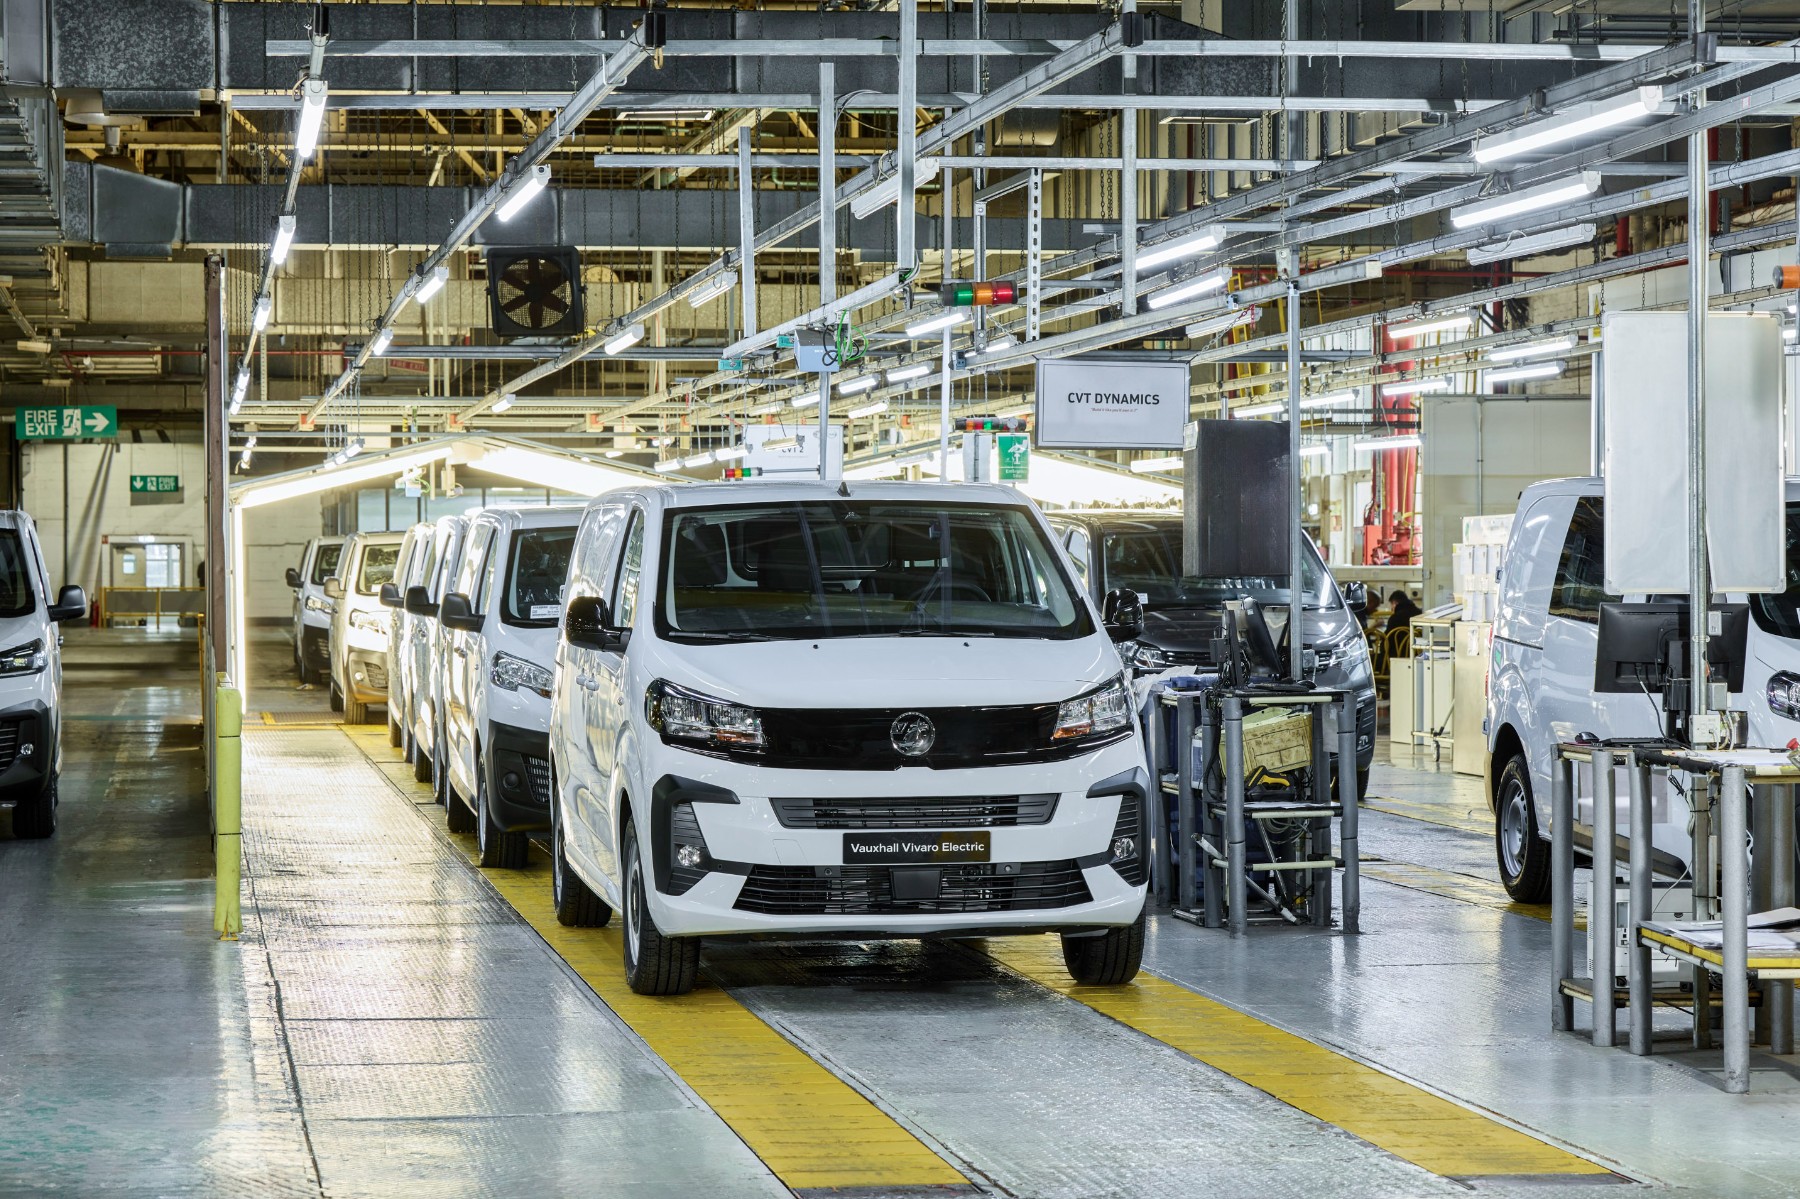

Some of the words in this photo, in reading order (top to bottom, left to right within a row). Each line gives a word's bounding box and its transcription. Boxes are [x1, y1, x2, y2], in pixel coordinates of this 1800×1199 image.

[1067, 392, 1091, 403] CVT
[1095, 393, 1160, 405] DYNAMICS
[25, 410, 57, 423] FIRE
[25, 422, 57, 436] EXIT
[851, 843, 899, 853] Vauxhall
[902, 842, 939, 852] Vivaro
[942, 842, 985, 852] Electric
